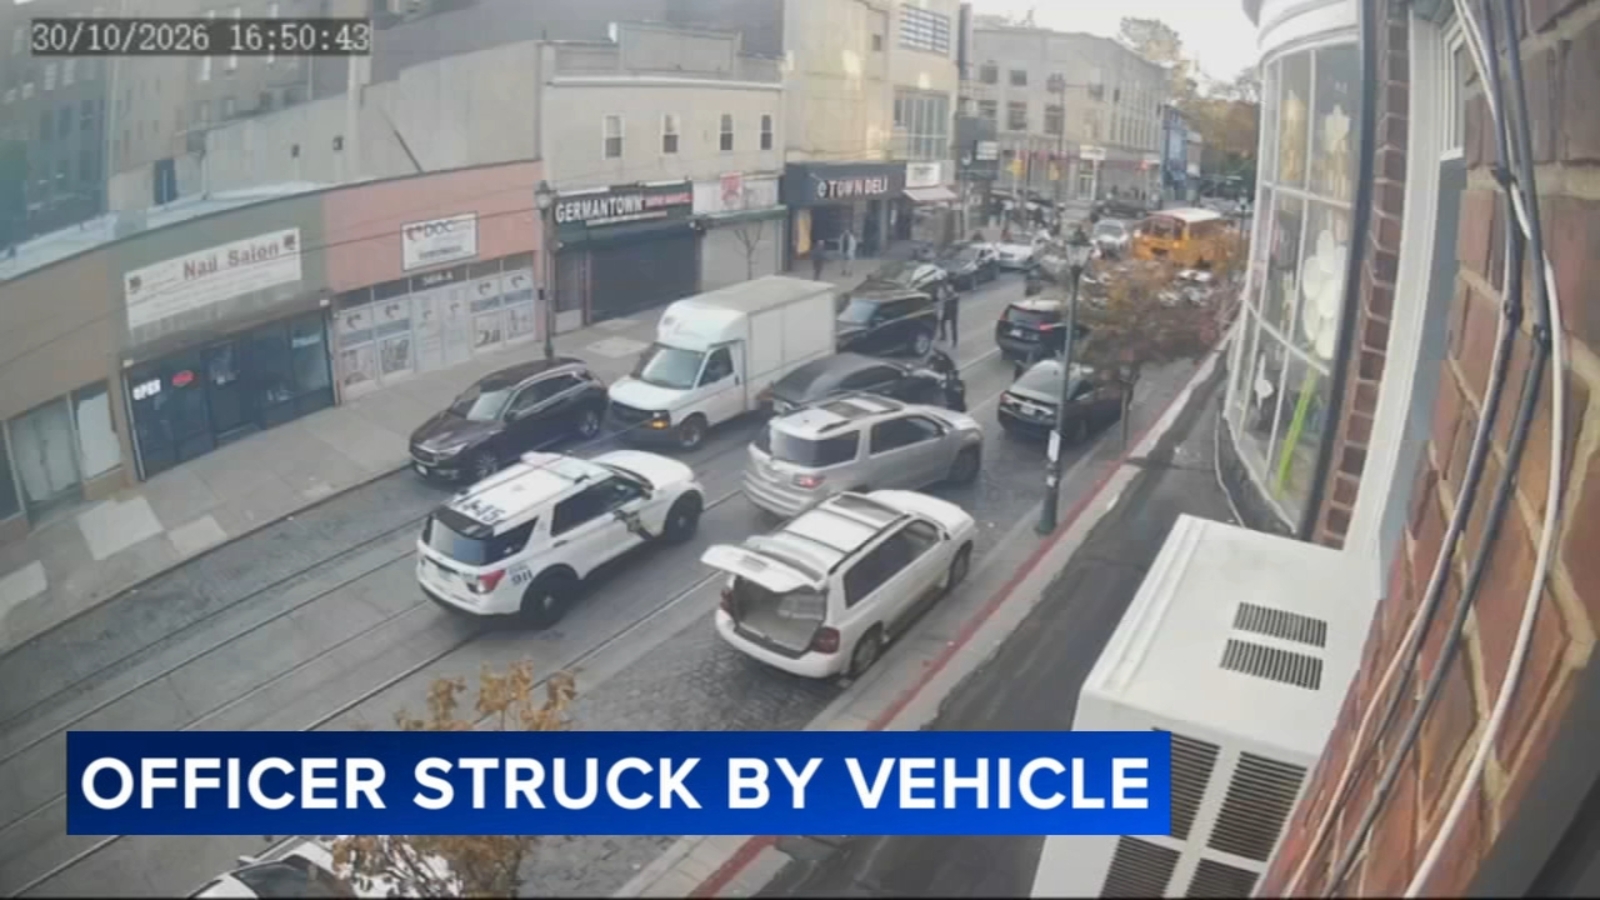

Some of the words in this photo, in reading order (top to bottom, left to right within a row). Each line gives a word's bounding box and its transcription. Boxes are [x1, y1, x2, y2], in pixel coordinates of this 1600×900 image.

[828, 179, 863, 198] TOWN
[864, 175, 888, 194] DELI
[555, 193, 642, 222] GERMANTOWN
[183, 254, 218, 280] Nail
[228, 242, 279, 266] Salon
